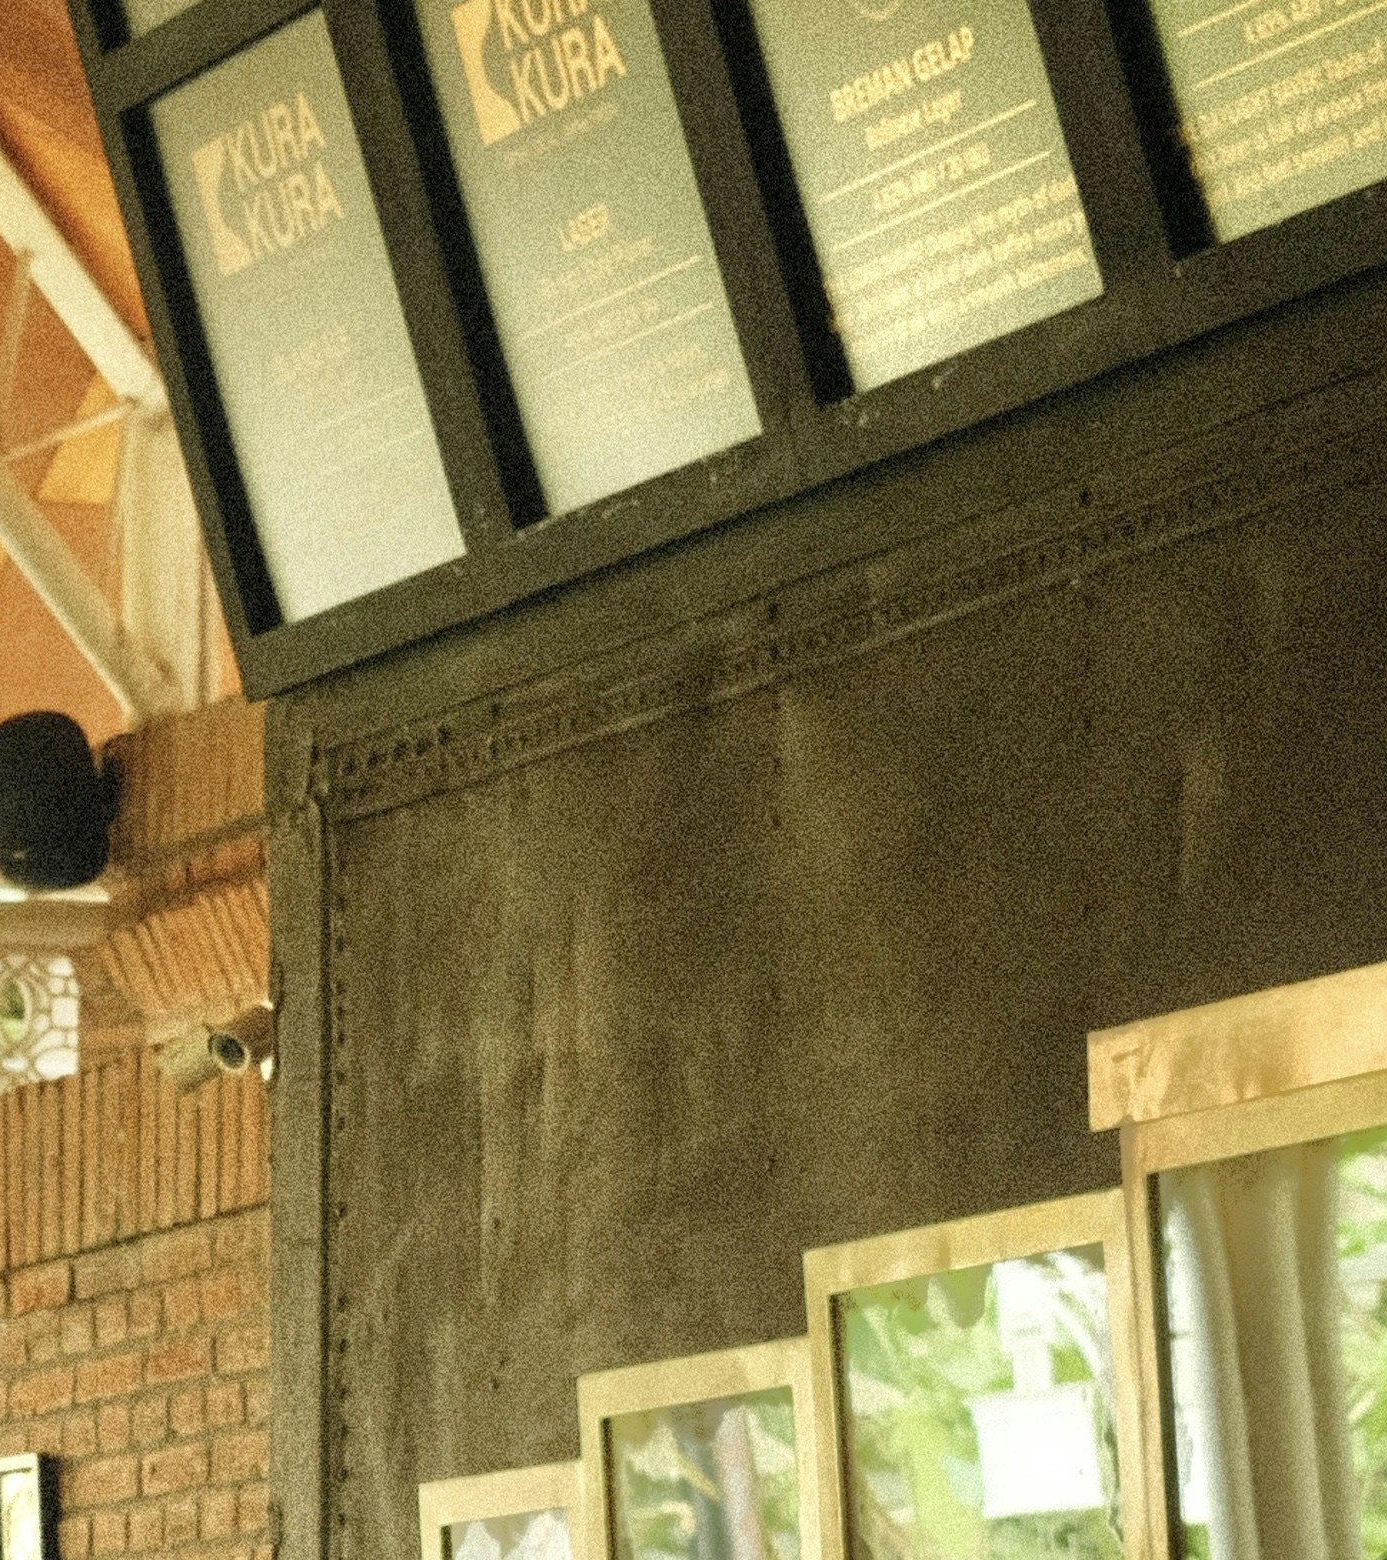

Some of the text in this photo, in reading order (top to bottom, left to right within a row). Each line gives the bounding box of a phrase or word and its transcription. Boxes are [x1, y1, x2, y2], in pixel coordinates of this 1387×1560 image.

[510, 17, 625, 122] KURA
[830, 26, 973, 122] BREMAN GELAP
[223, 94, 325, 191] KURA
[244, 164, 342, 258] KURA
